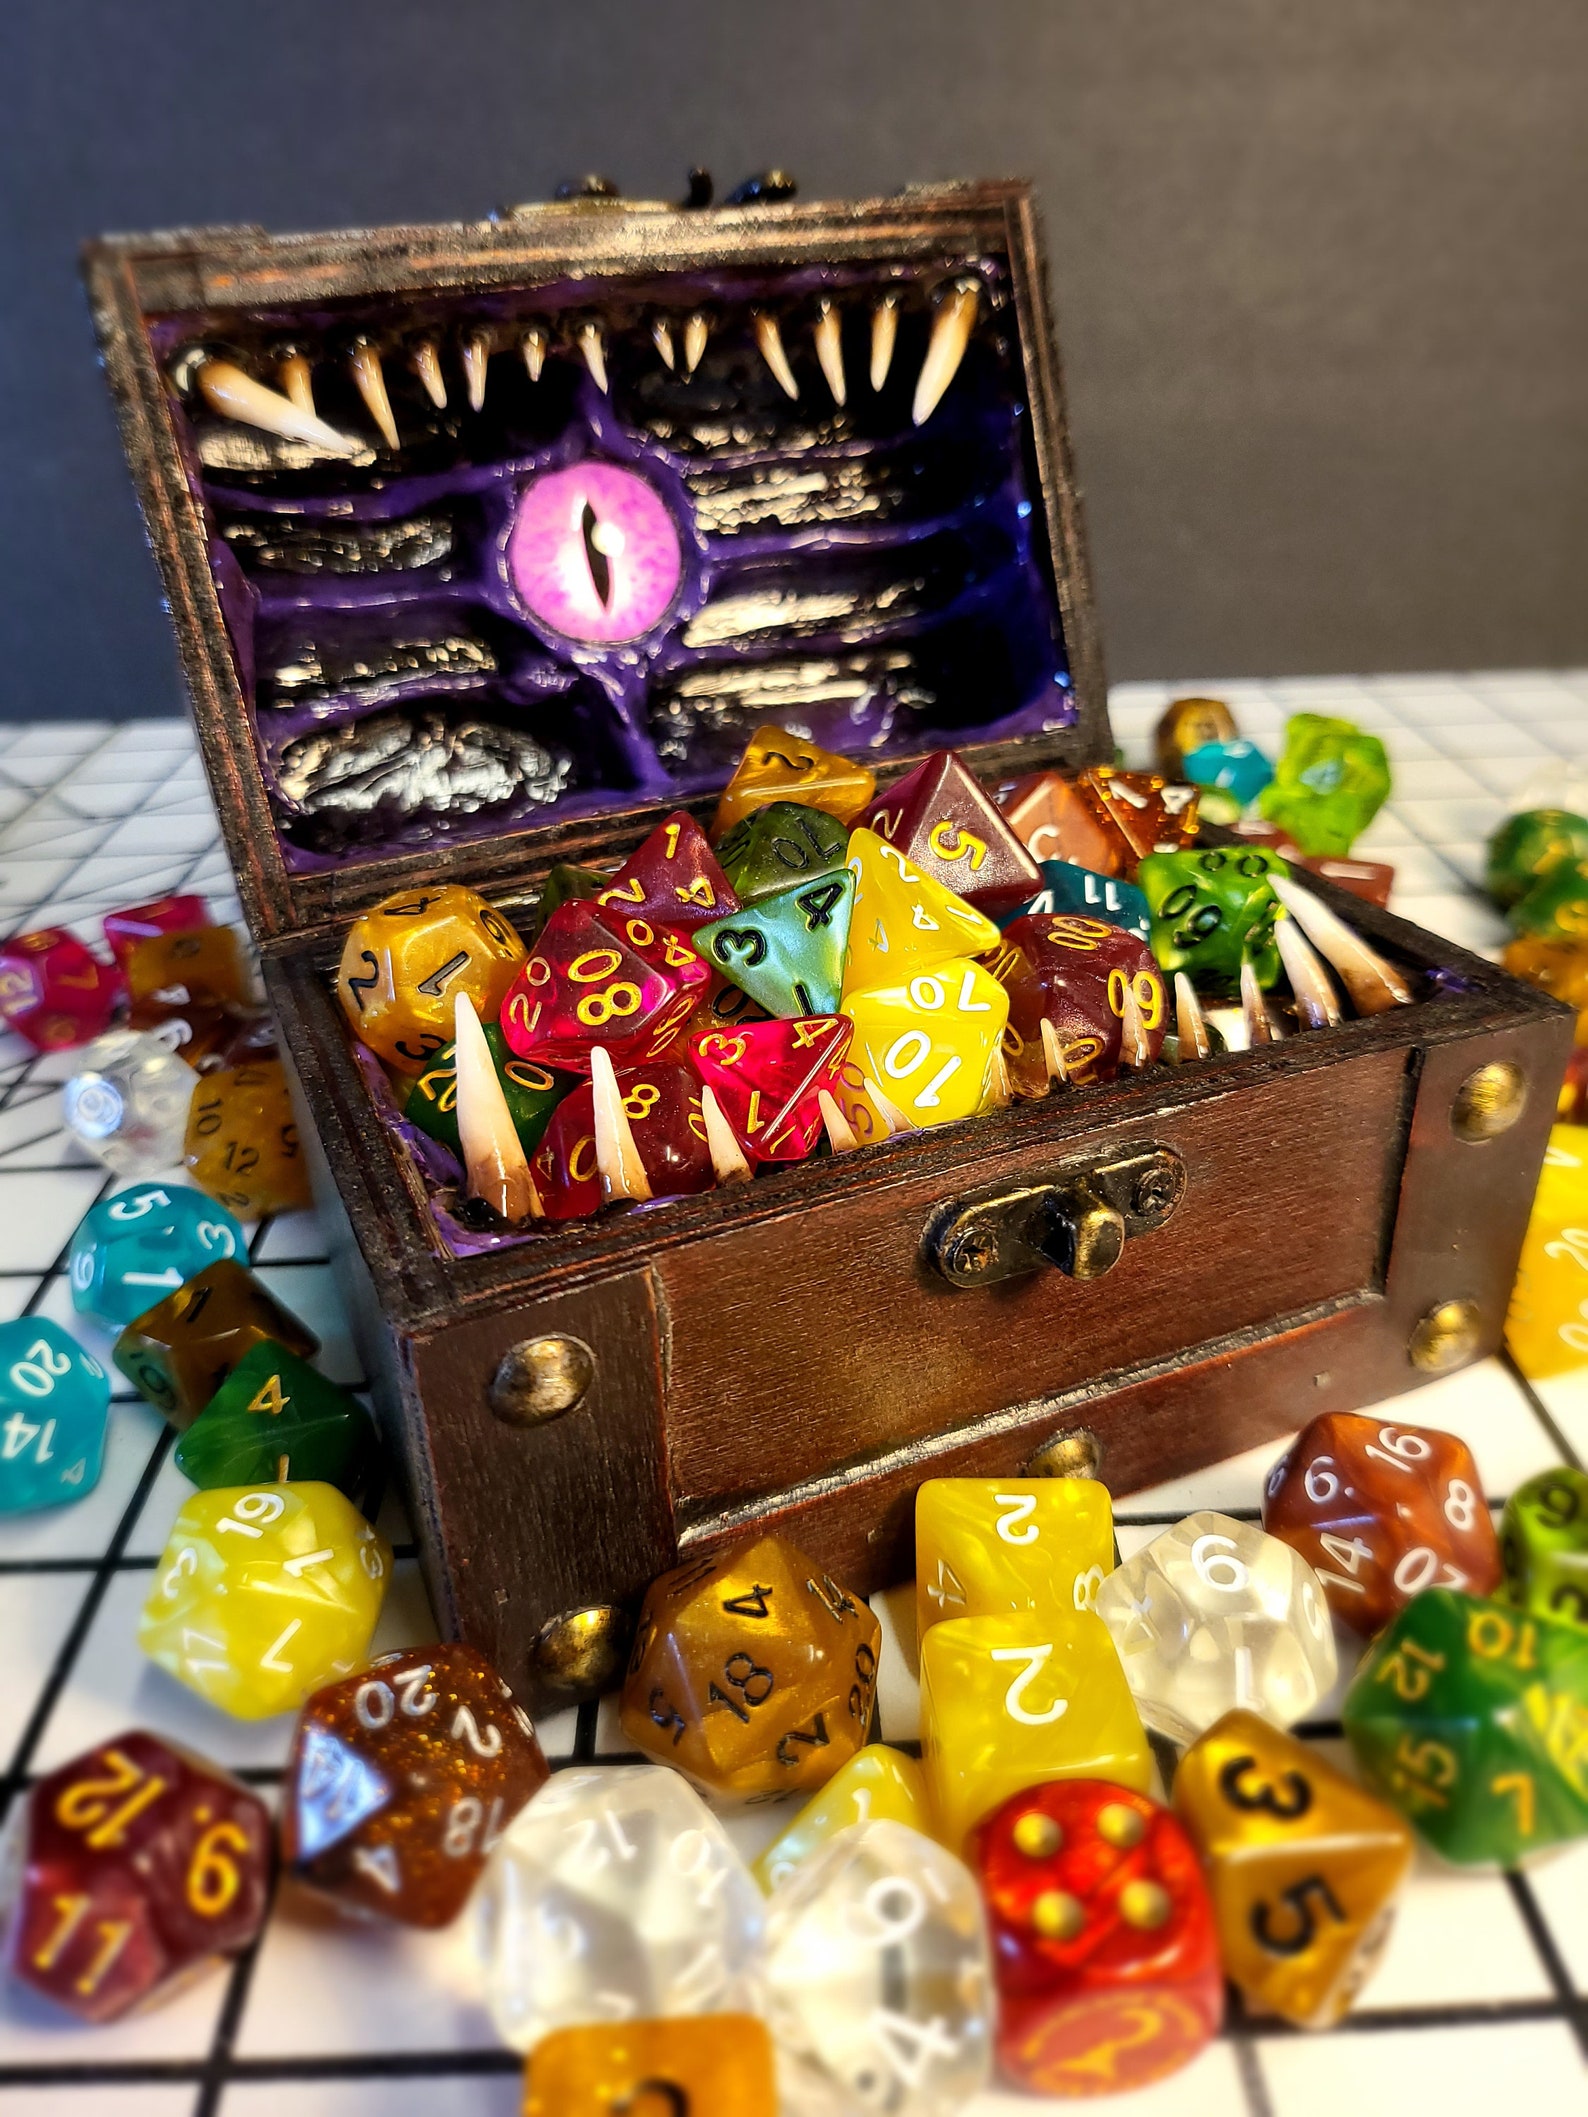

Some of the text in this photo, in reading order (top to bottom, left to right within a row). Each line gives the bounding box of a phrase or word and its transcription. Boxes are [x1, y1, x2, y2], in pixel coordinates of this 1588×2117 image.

[664, 823, 681, 859] 1
[880, 846, 920, 883] 2
[928, 821, 988, 871] 5
[675, 876, 716, 909] 4
[797, 882, 844, 932] 4
[712, 929, 767, 966] 3
[349, 950, 379, 1011] 2
[698, 1034, 746, 1066] 3
[791, 1018, 839, 1049] 4
[884, 1030, 962, 1108] 10
[747, 1091, 765, 1134] 1
[108, 1190, 173, 1221] 5
[197, 1220, 235, 1258] 3
[121, 1266, 184, 1288] 1
[9, 1339, 72, 1397] 20
[248, 1375, 291, 1415] 4
[2, 1411, 57, 1464] 14
[1364, 1425, 1433, 1474] 16
[215, 1492, 285, 1539] 19
[993, 1494, 1040, 1546] 2
[1443, 1478, 1477, 1532] 8
[162, 1547, 198, 1599] 3
[282, 1549, 334, 1578] 1
[1314, 1531, 1375, 1594] 14
[723, 1584, 773, 1617] 4
[806, 1574, 859, 1624] 14
[260, 1618, 302, 1673] 7
[1468, 1611, 1537, 1670] 10
[709, 1652, 774, 1724] 18
[990, 1643, 1068, 1725] 2
[1376, 1638, 1446, 1700] 12
[355, 1664, 437, 1729] 20
[451, 1705, 503, 1758] 2
[776, 1712, 831, 1766] 2
[57, 1749, 167, 1850] 12
[1219, 1756, 1312, 1822] 3
[1249, 1871, 1348, 1957] 5
